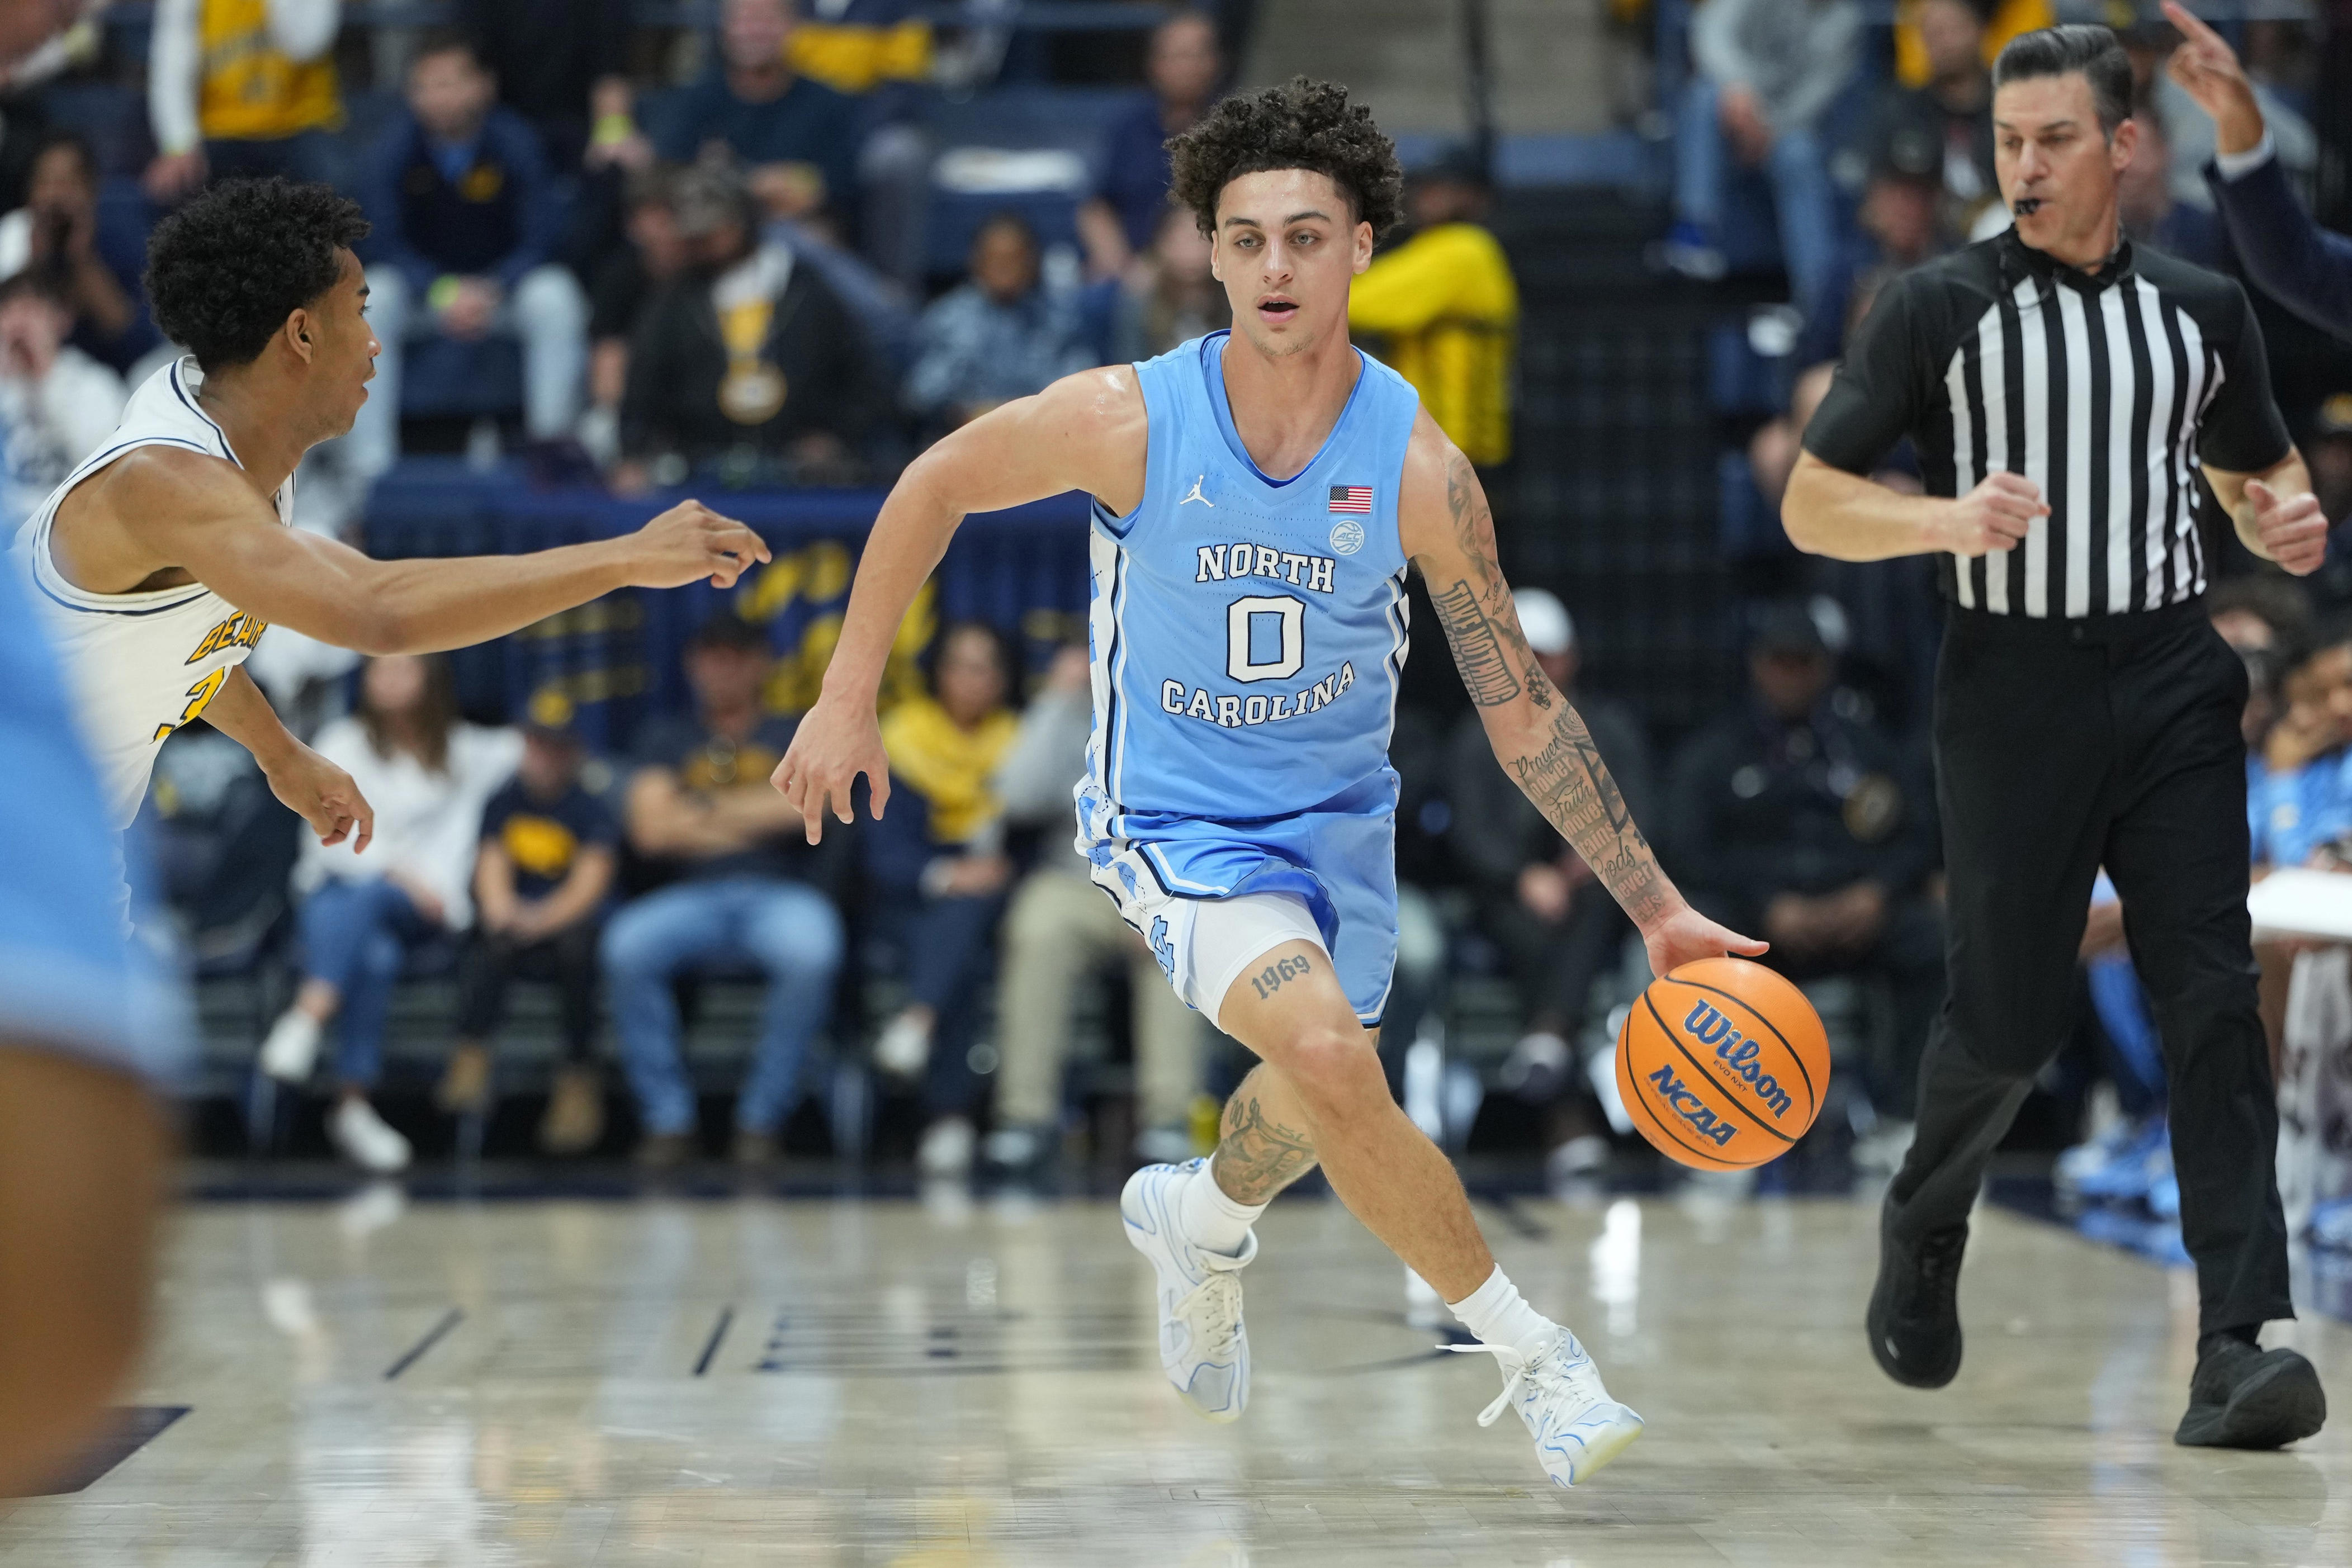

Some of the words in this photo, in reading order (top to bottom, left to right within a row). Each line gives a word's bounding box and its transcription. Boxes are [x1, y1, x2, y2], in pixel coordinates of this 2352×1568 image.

[1333, 532, 1362, 543] ACC
[1195, 542, 1336, 594] NORTH
[1437, 580, 1484, 631] TAKE
[184, 610, 268, 666] BEAR
[1226, 594, 1306, 684] 0
[1456, 625, 1520, 705] NOTHING
[1161, 660, 1356, 728] CAROLINA
[1507, 735, 1561, 785] Prayer
[1548, 775, 1593, 829] Faith
[1252, 954, 1311, 999] 1969
[1683, 998, 1792, 1120] Wilson
[1713, 1059, 1731, 1077] EVO
[1730, 1076, 1748, 1092] NXT
[1649, 1063, 1738, 1147] NCAA
